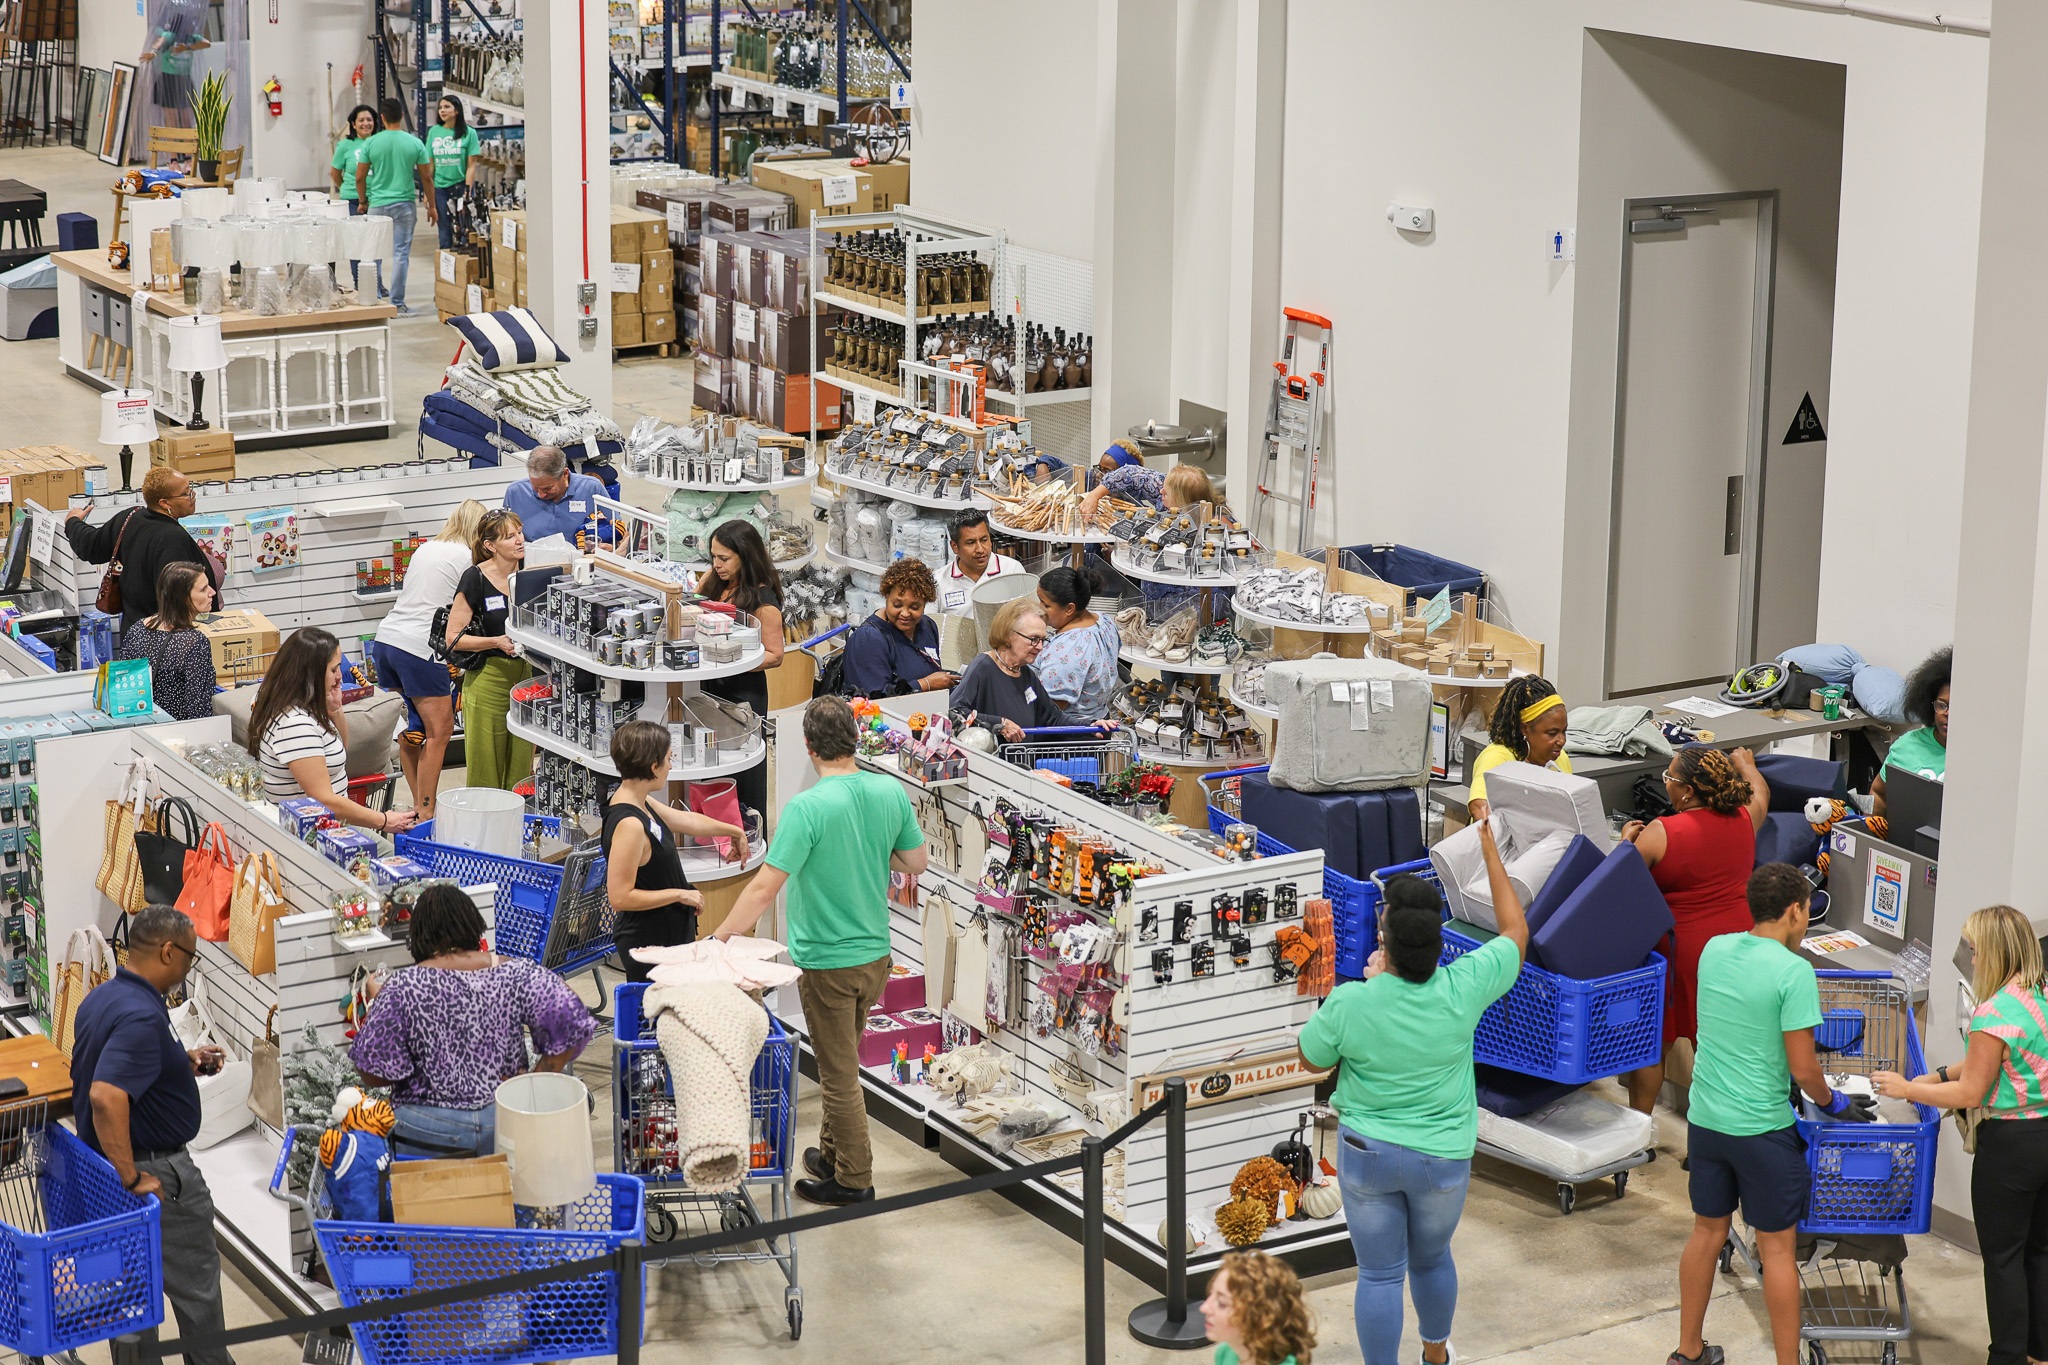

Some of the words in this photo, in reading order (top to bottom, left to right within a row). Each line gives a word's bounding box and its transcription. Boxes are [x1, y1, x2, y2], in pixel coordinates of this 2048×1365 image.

[1876, 855, 1903, 872] GIVEAWAY
[977, 886, 992, 898] pop!
[1058, 955, 1073, 967] pop!
[1234, 1063, 1305, 1085] HALLOWE
